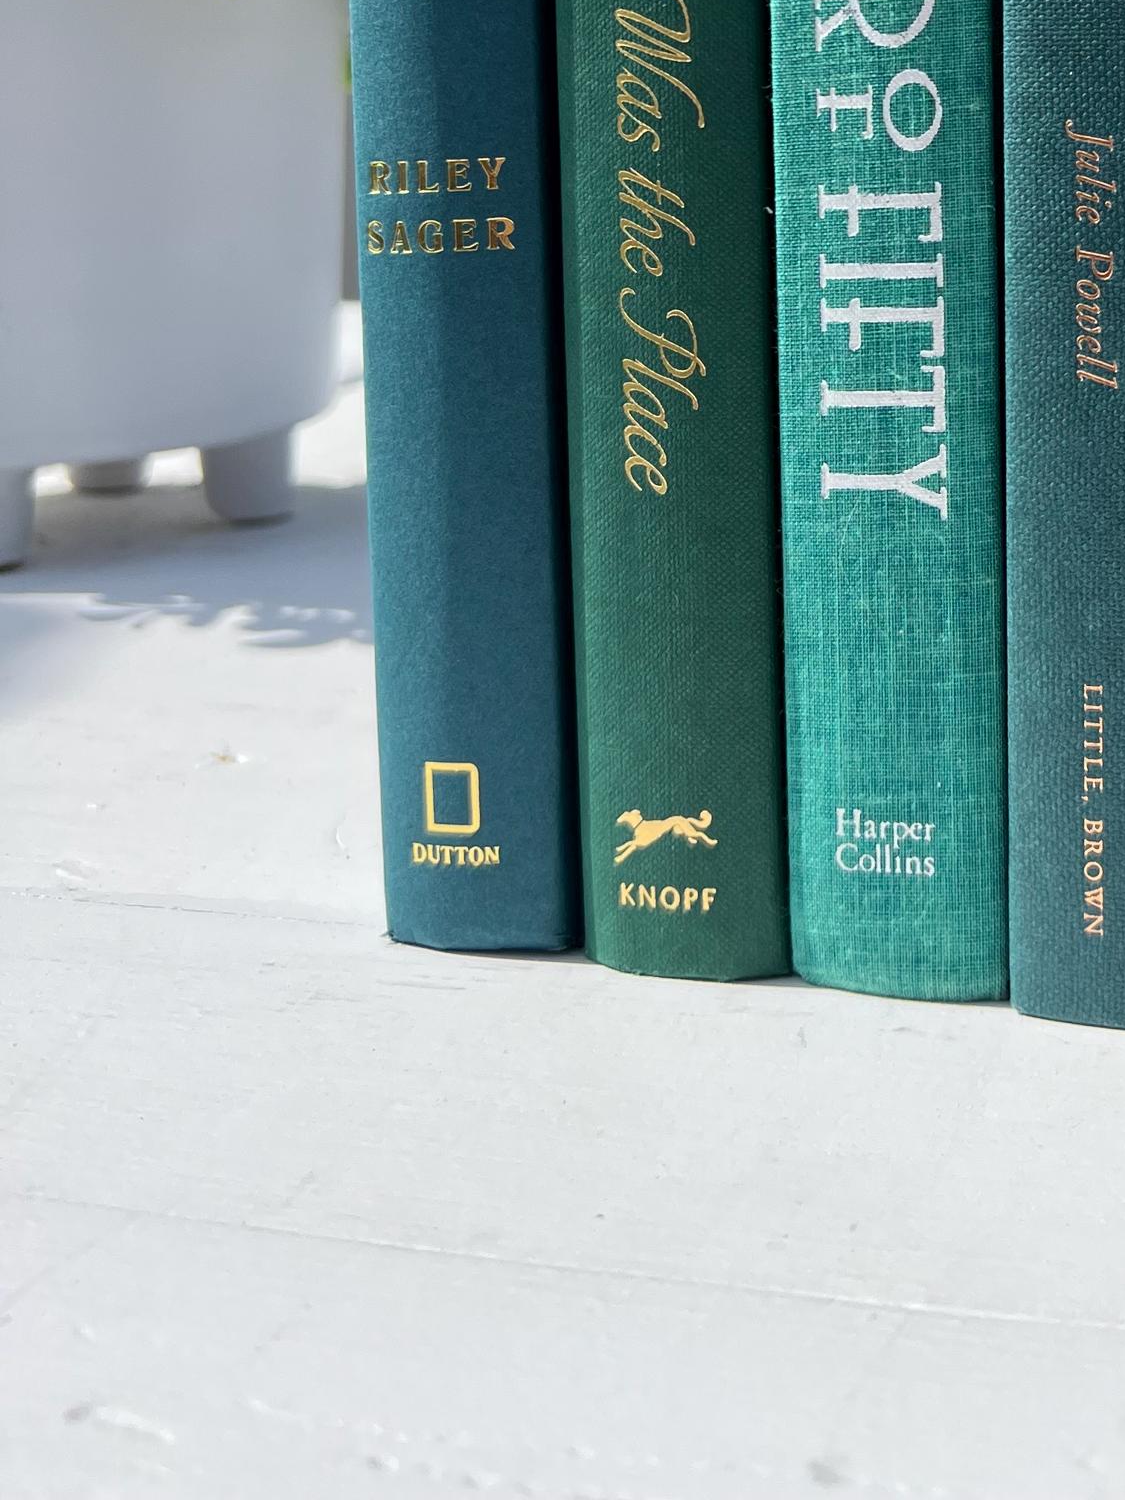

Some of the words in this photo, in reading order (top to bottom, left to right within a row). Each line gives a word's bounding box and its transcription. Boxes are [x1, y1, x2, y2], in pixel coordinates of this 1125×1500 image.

[815, 69, 945, 153] OF
[368, 156, 507, 196] RILEY
[1064, 119, 1114, 226] Julie
[367, 216, 516, 256] SAGER
[617, 167, 697, 278] the
[817, 181, 949, 522] FIFTY
[1076, 244, 1118, 391] Powell
[620, 285, 707, 498] Place
[1080, 682, 1105, 803] LITTLE,
[411, 842, 501, 866] DUTTON
[835, 807, 937, 846] Harper
[835, 842, 937, 877] Collins
[617, 883, 718, 913] KNOPF
[1083, 817, 1105, 937] BROWN
